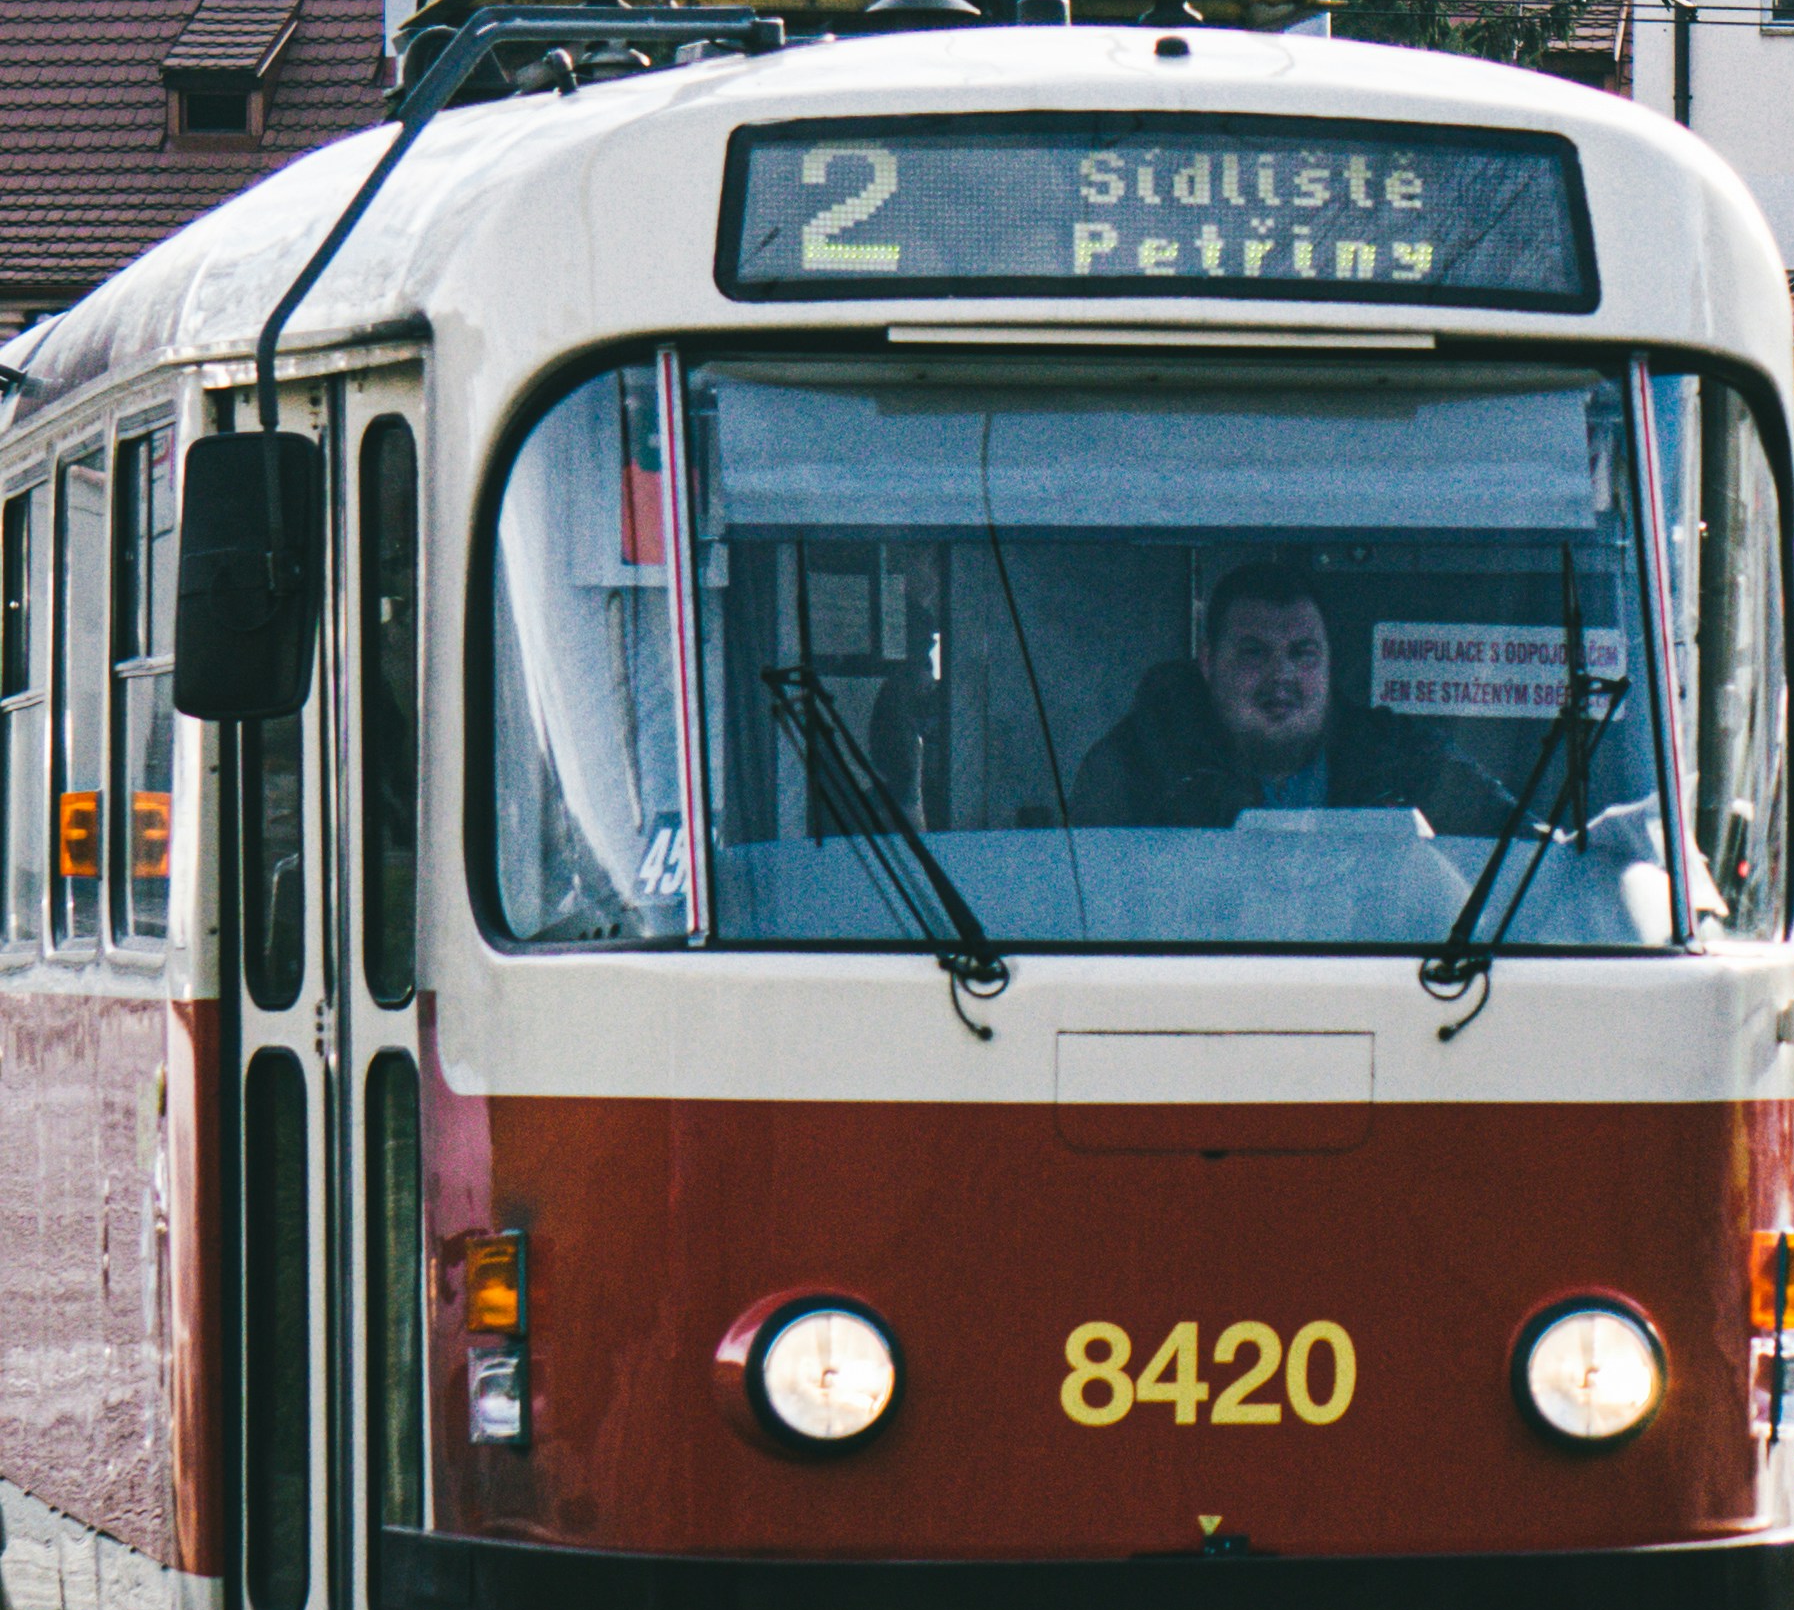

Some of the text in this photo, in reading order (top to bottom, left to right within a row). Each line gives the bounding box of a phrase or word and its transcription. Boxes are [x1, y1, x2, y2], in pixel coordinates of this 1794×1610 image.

[800, 142, 900, 272] 2
[1079, 148, 1424, 209] Sídliště
[1072, 217, 1434, 279] Petřiny
[1381, 639, 1617, 666] MANIPULACE S ODPOJOČEM
[1379, 679, 1411, 703] JEN
[1415, 680, 1436, 703] SE
[1440, 677, 1530, 706] STAŽENÝM
[1060, 1320, 1358, 1426] 8420
